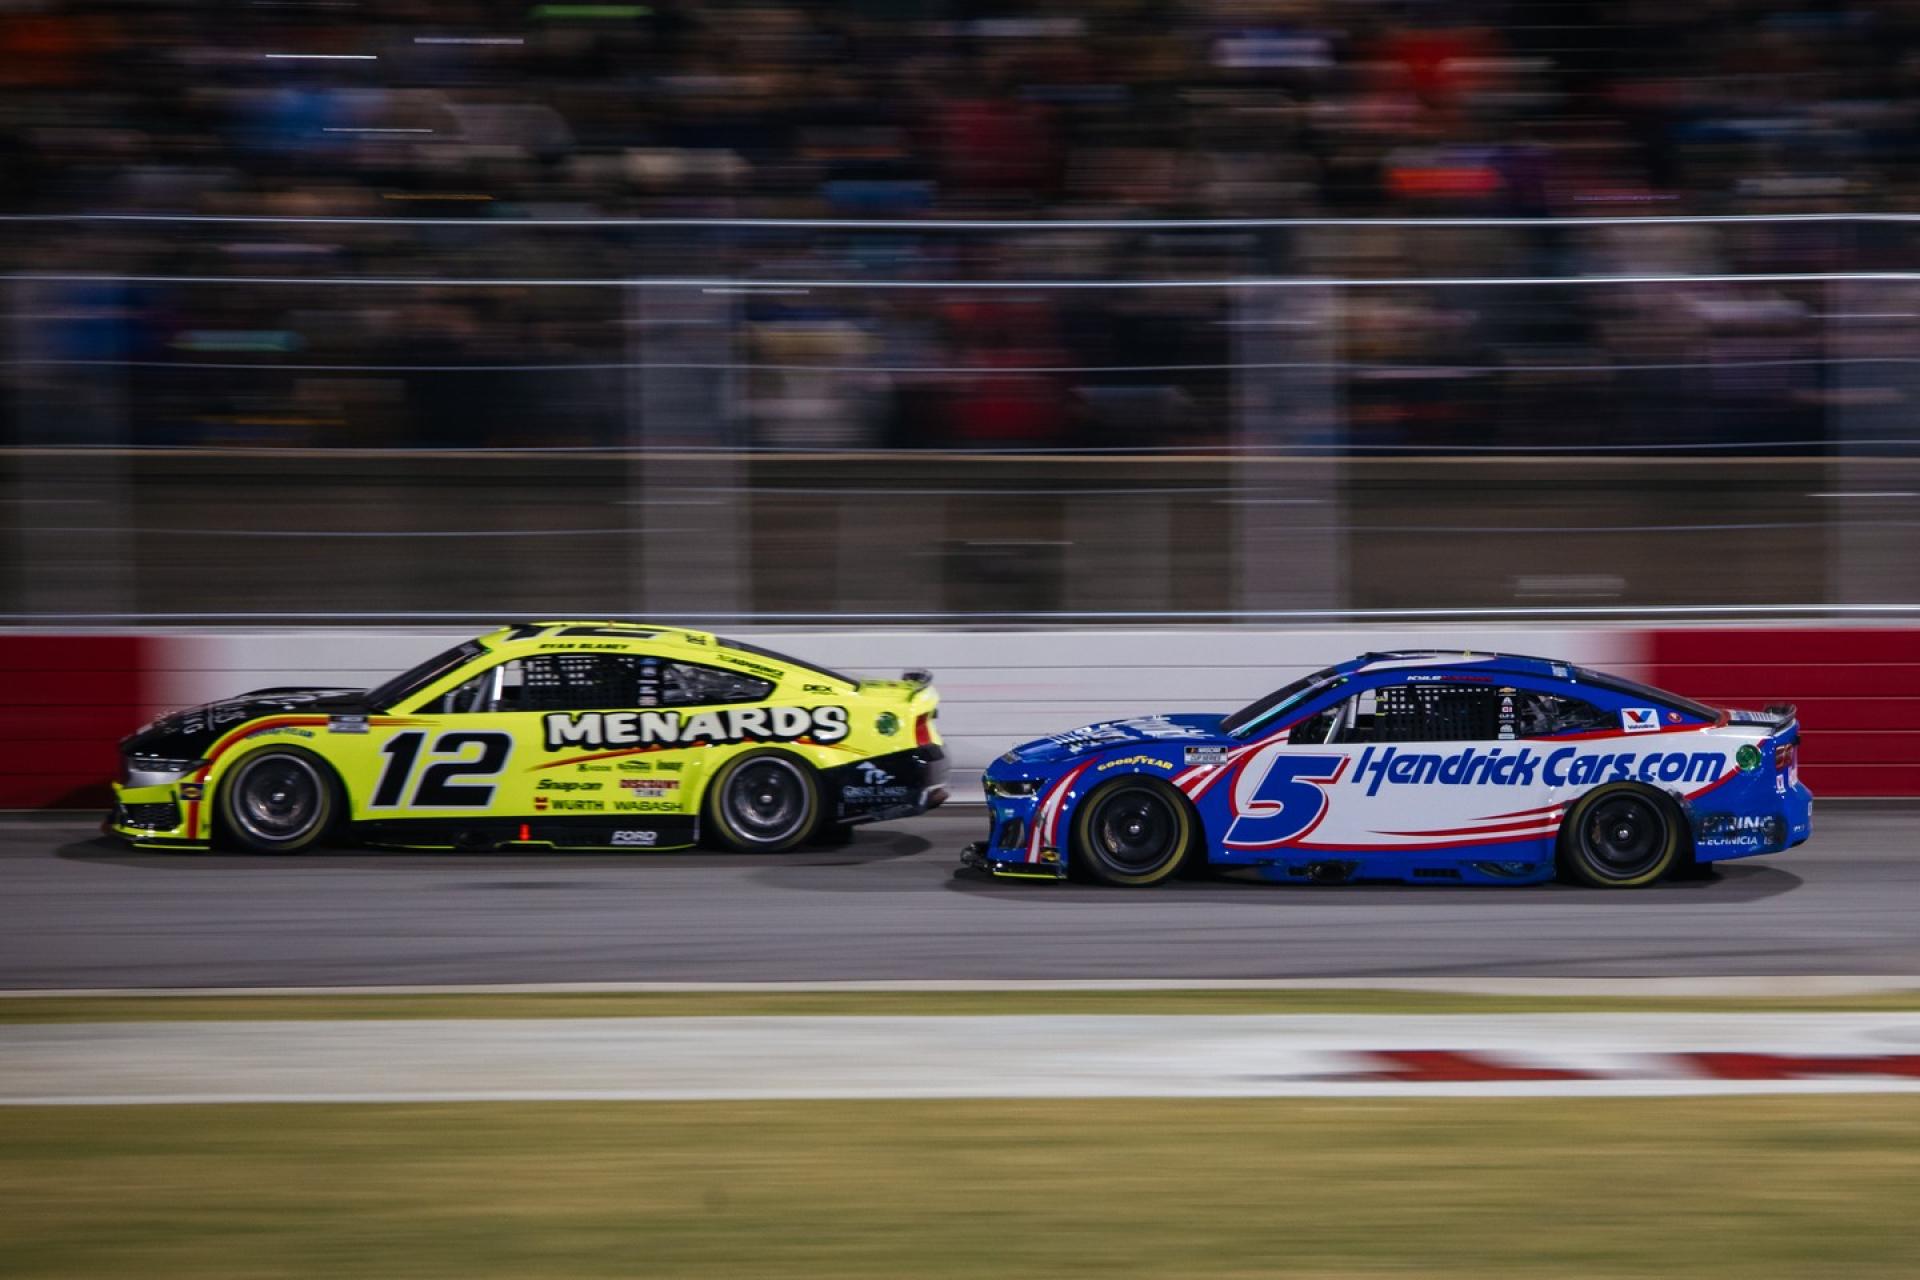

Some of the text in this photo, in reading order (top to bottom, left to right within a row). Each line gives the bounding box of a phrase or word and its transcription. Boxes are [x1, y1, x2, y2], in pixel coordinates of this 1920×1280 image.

[545, 706, 849, 750] MENARDS
[369, 730, 513, 809] 12
[1097, 755, 1173, 771] GOODYEAR
[536, 779, 603, 792] Snap-on
[613, 801, 683, 811] WABASH
[1223, 751, 1351, 846] 5
[612, 830, 658, 841] FORD
